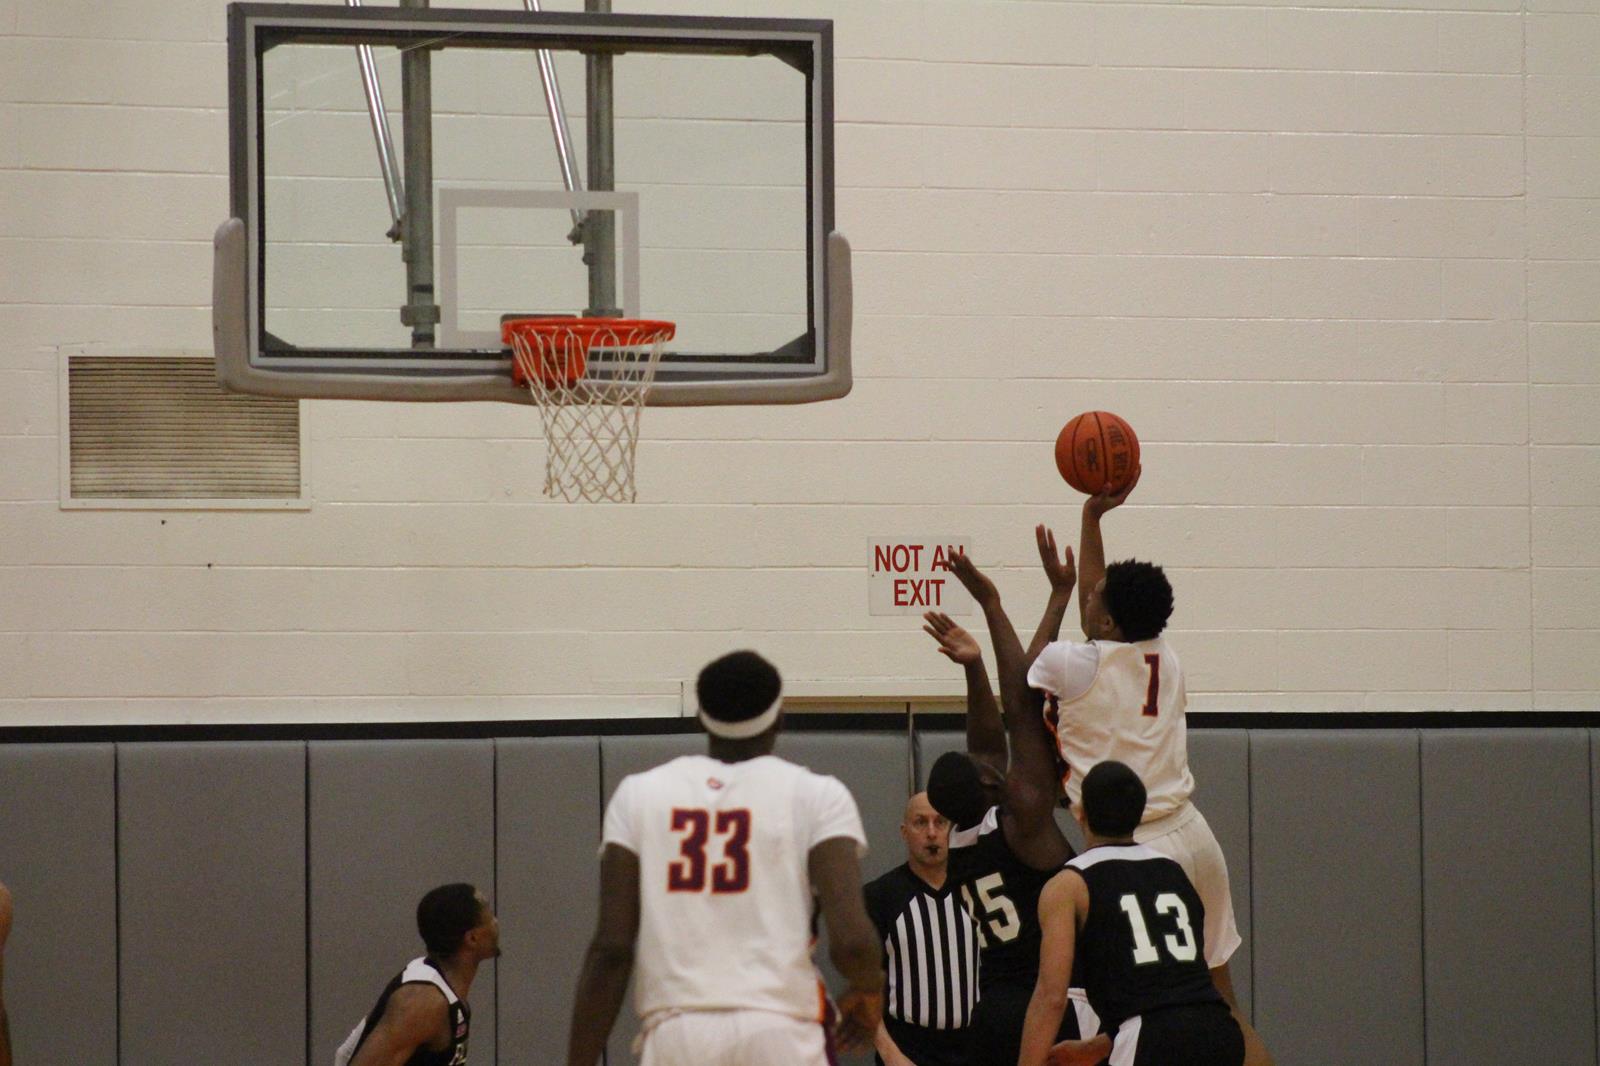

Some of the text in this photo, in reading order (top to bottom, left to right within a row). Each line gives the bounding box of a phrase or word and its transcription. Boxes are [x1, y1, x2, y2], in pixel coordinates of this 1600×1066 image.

[875, 544, 924, 573] NOT
[893, 579, 945, 606] EXIT
[1142, 653, 1159, 717] 1
[667, 806, 751, 895] 33
[1119, 892, 1197, 964] 13
